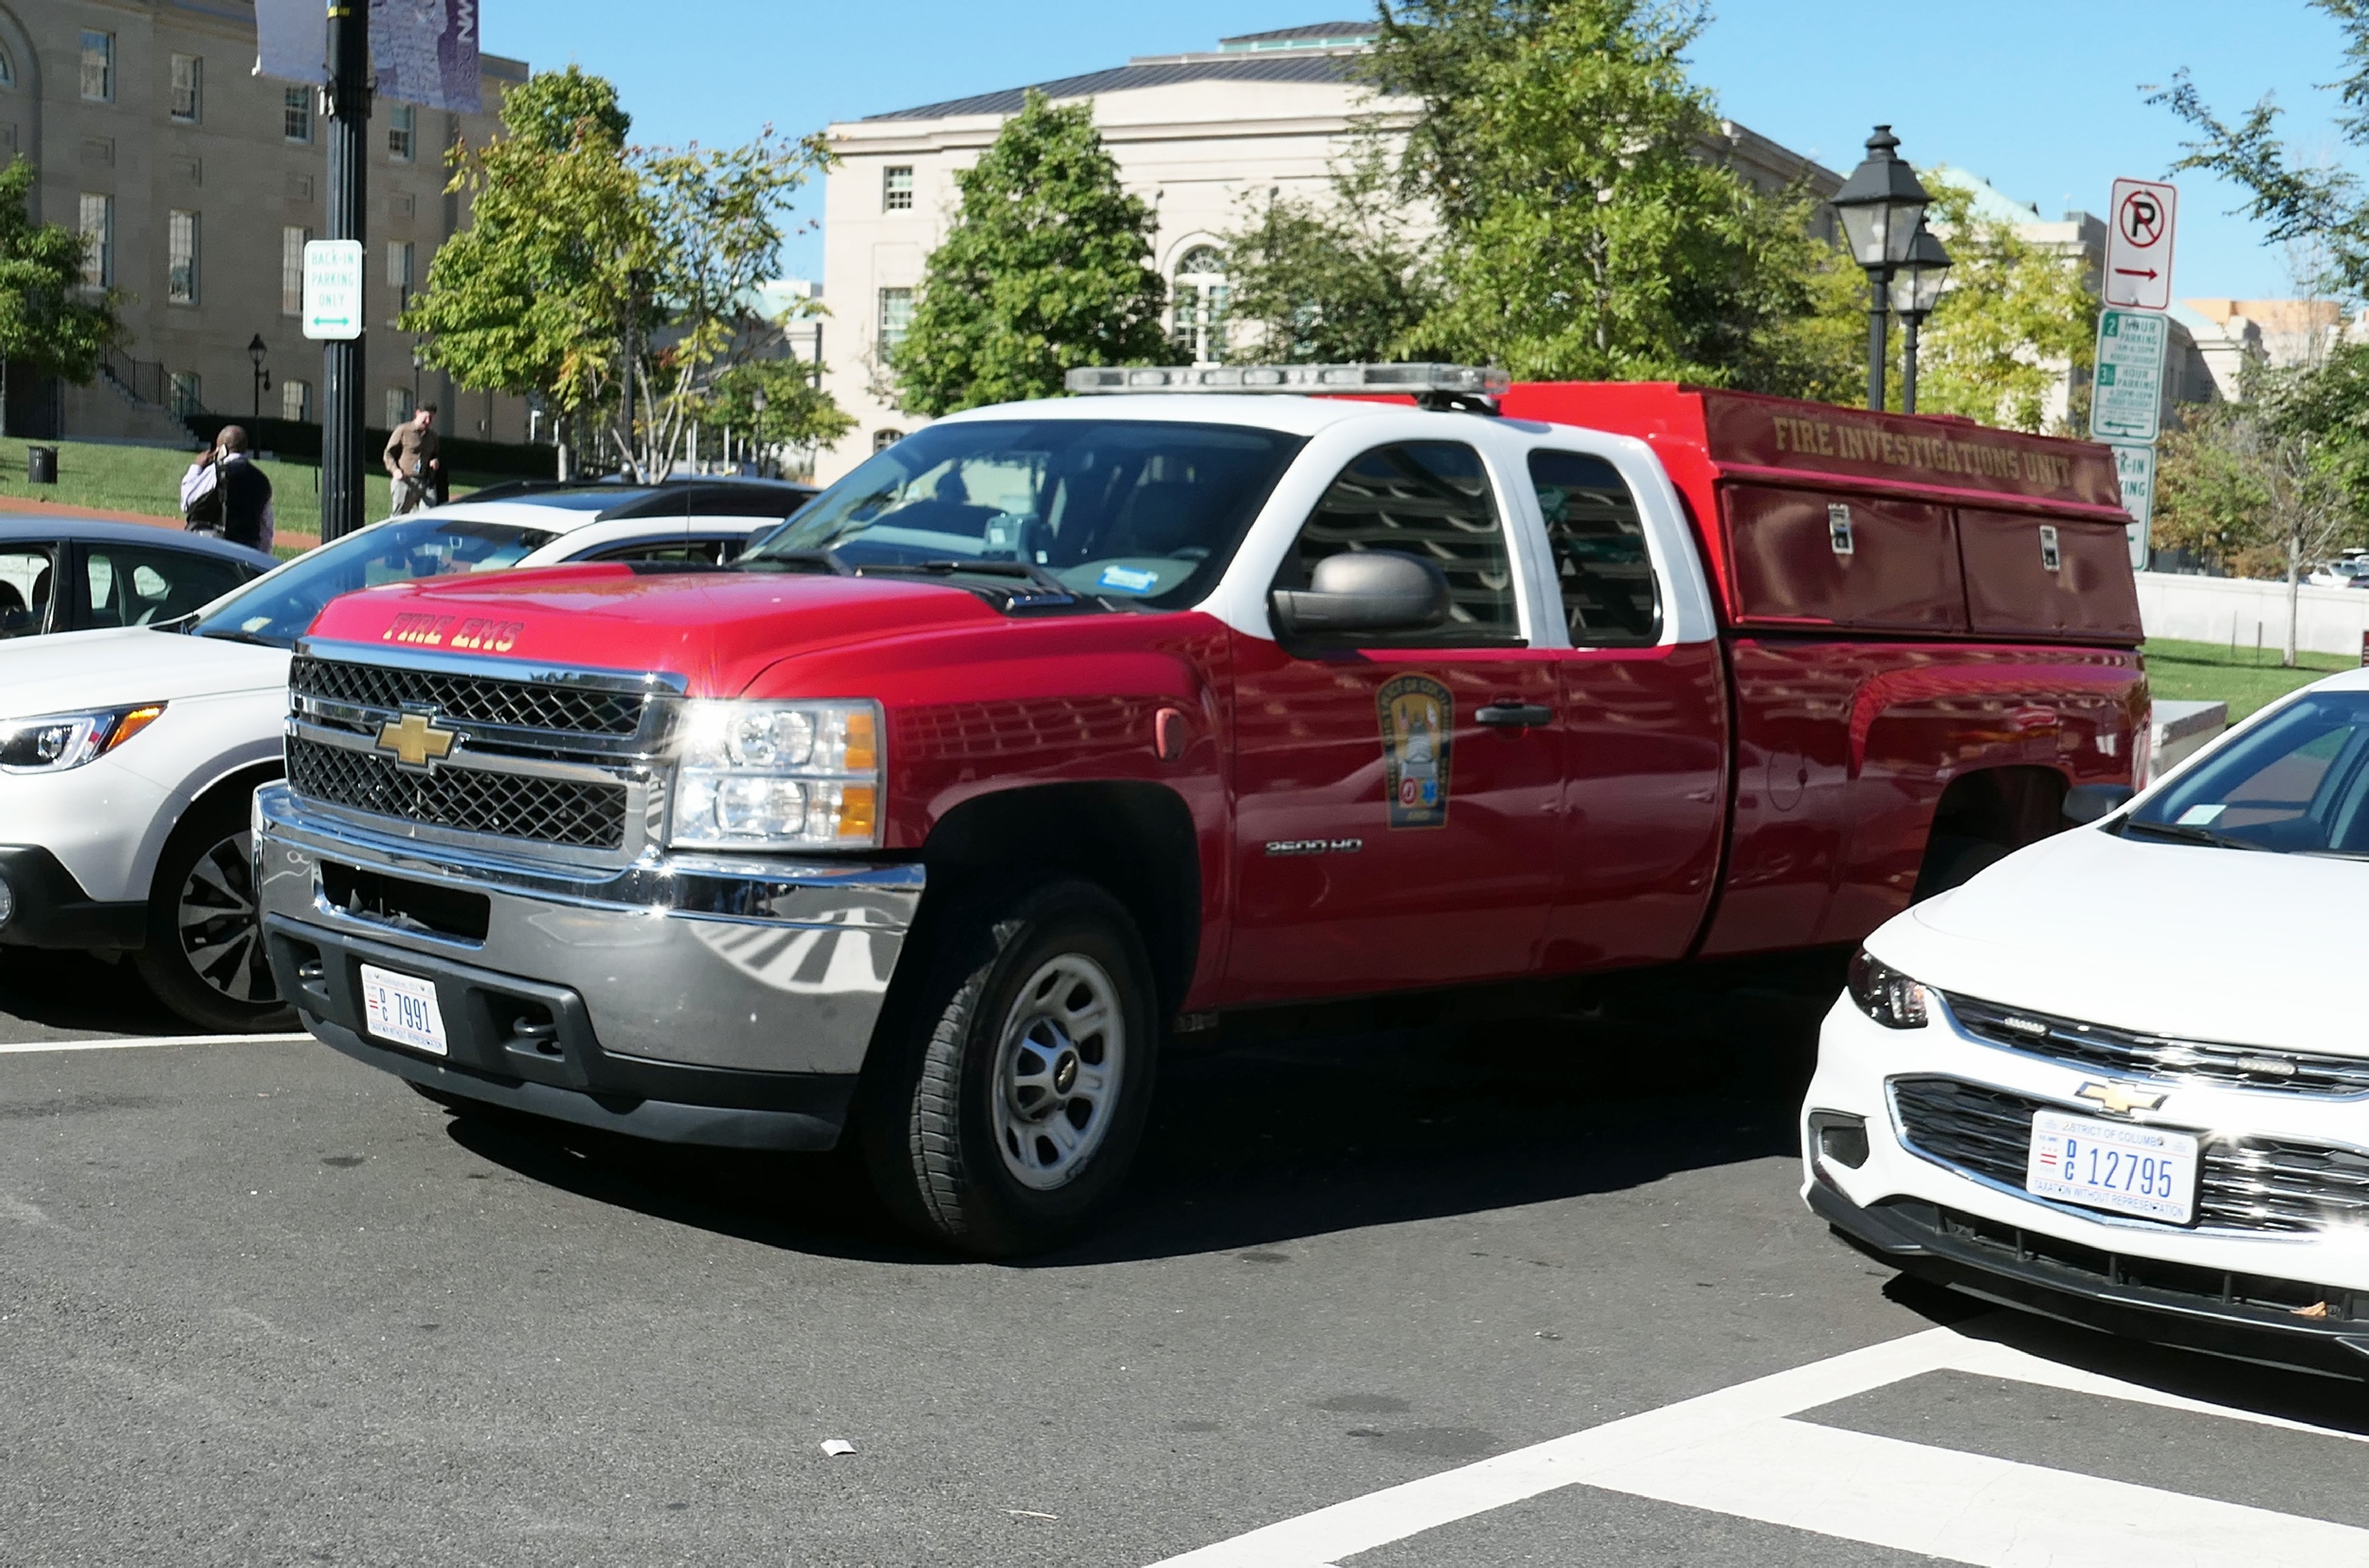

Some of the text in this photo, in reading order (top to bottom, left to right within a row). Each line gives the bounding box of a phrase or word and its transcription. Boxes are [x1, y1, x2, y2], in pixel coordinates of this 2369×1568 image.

[312, 252, 354, 265] BACK-IN
[312, 273, 354, 287] PARKING
[319, 294, 345, 307] ONLY
[2107, 318, 2157, 335] 2 HOUR
[2120, 332, 2158, 346] PARKING
[2124, 369, 2149, 379] HOUR
[2117, 378, 2156, 390] PARKING
[1773, 417, 2072, 487] FIRE INVESTIGATIONS UNIT
[2118, 457, 2144, 474] K-IN
[382, 612, 525, 653] FIRE EMS
[394, 992, 431, 1034] 7991
[2104, 1128, 2116, 1139] OF
[2088, 1147, 2173, 1198] 12795
[2034, 1180, 2183, 1217] TAXATION WITHOUT REPRESENTATION
